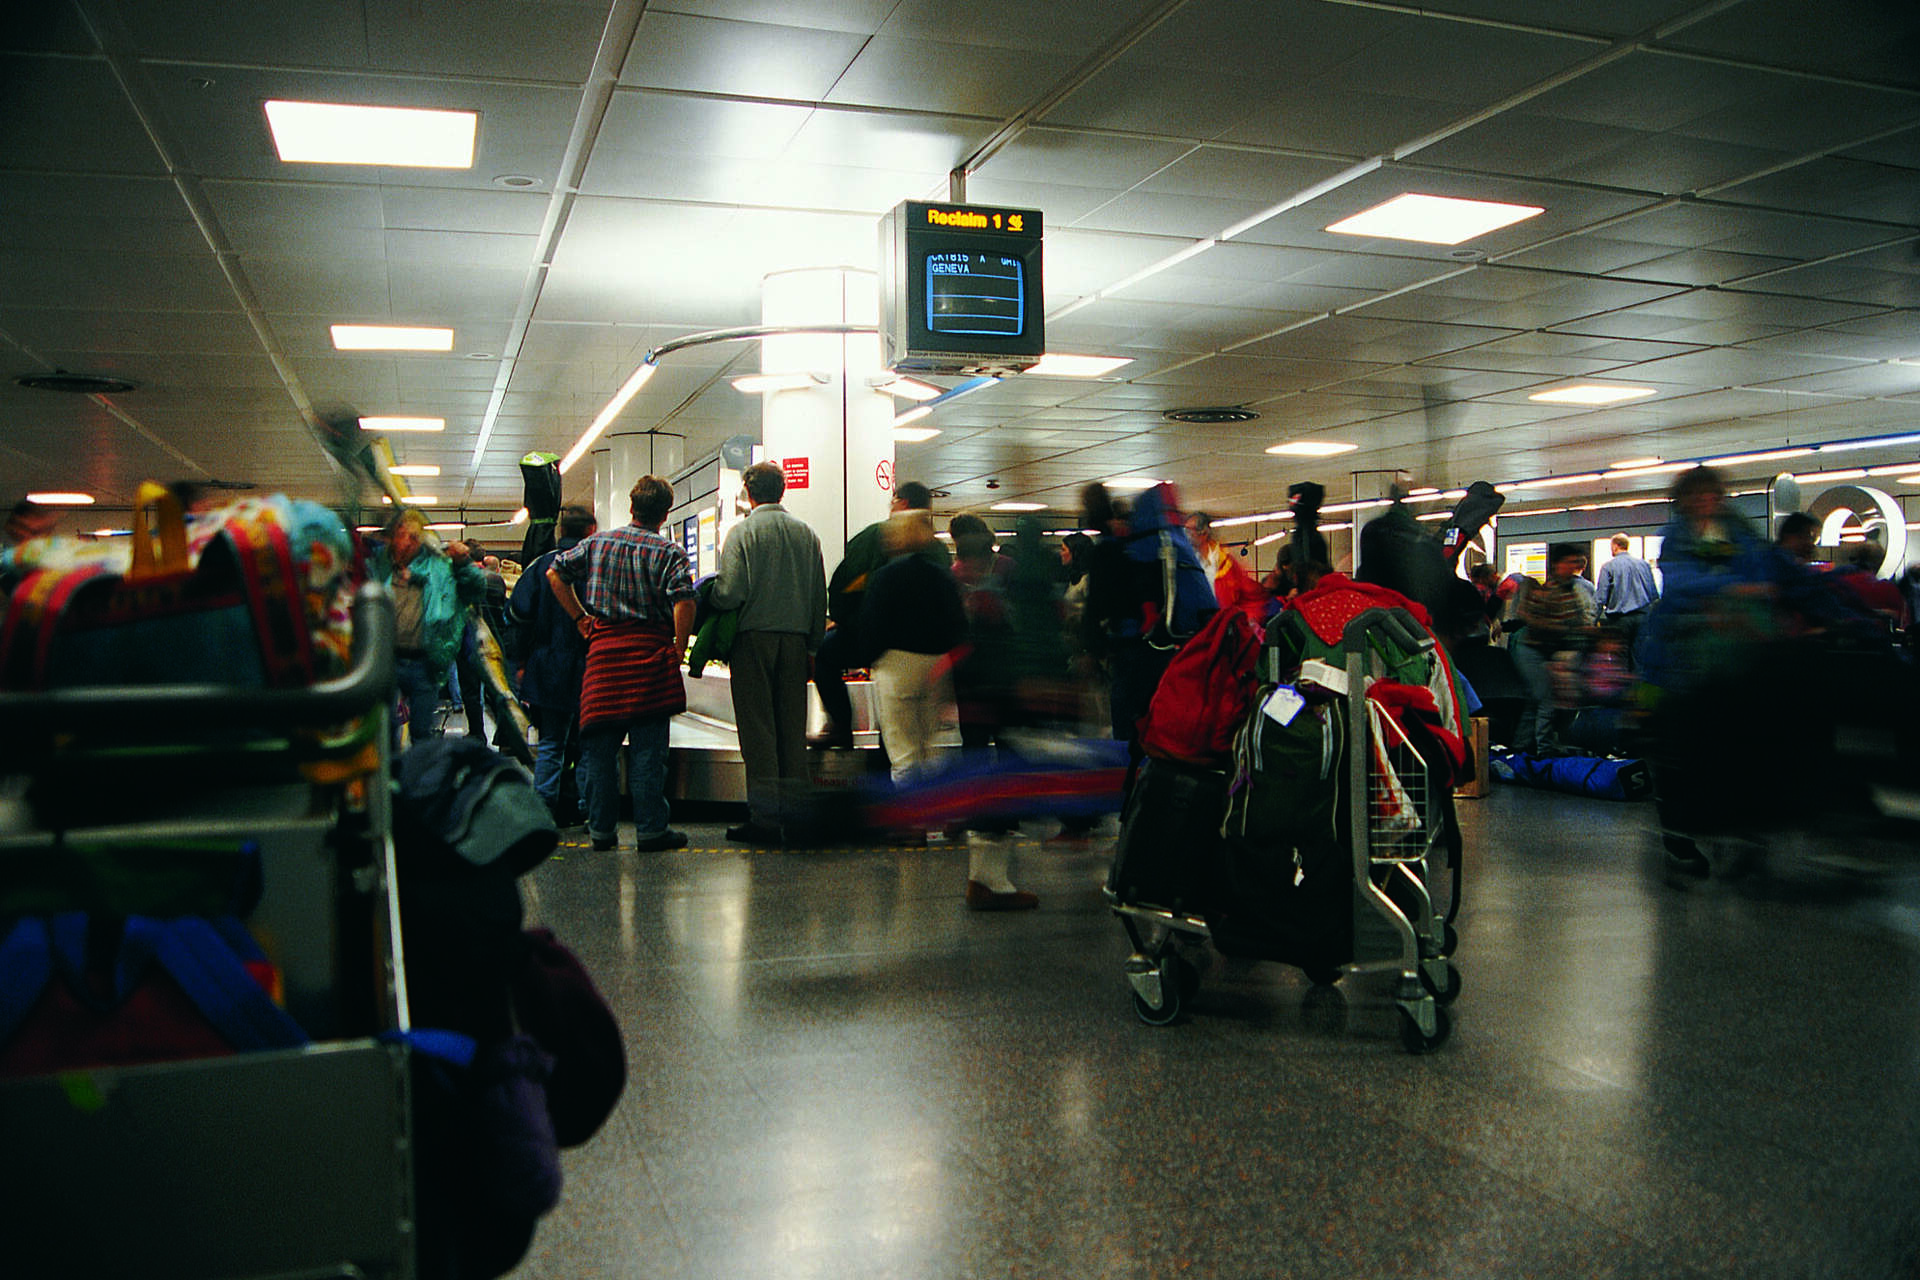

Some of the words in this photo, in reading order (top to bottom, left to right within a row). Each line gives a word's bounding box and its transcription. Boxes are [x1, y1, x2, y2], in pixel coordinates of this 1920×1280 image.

[927, 208, 988, 228] Reclaim
[992, 213, 1002, 229] 1
[932, 263, 970, 273] GENEVA
